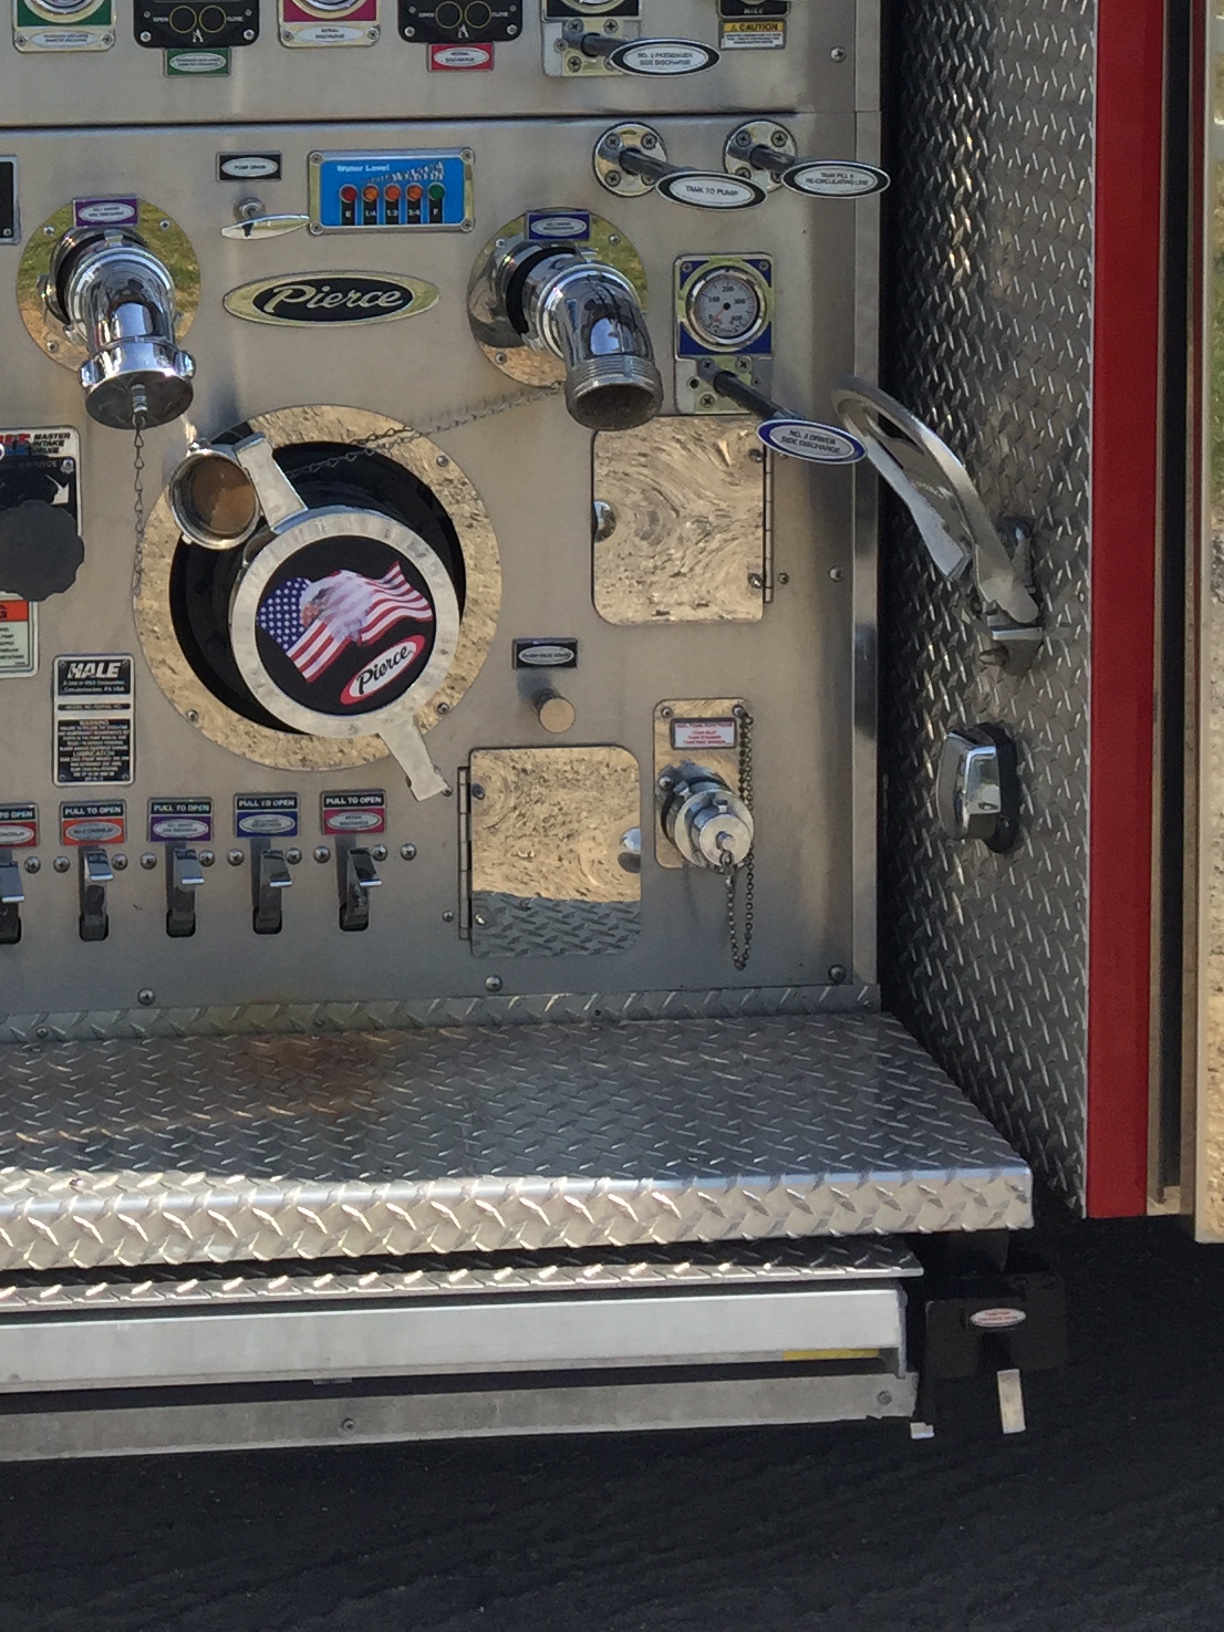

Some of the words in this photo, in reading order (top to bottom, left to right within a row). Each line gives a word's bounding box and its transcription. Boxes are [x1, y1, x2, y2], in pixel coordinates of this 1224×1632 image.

[739, 22, 778, 32] CAUTION
[337, 164, 363, 172] Water
[365, 164, 390, 172] Level
[263, 284, 404, 314] Pierce
[781, 436, 798, 445] SIDE
[799, 439, 841, 453] DISCHARGE
[809, 433, 837, 445] DRIVER
[67, 662, 121, 678] HALE
[356, 645, 411, 695] Pierce
